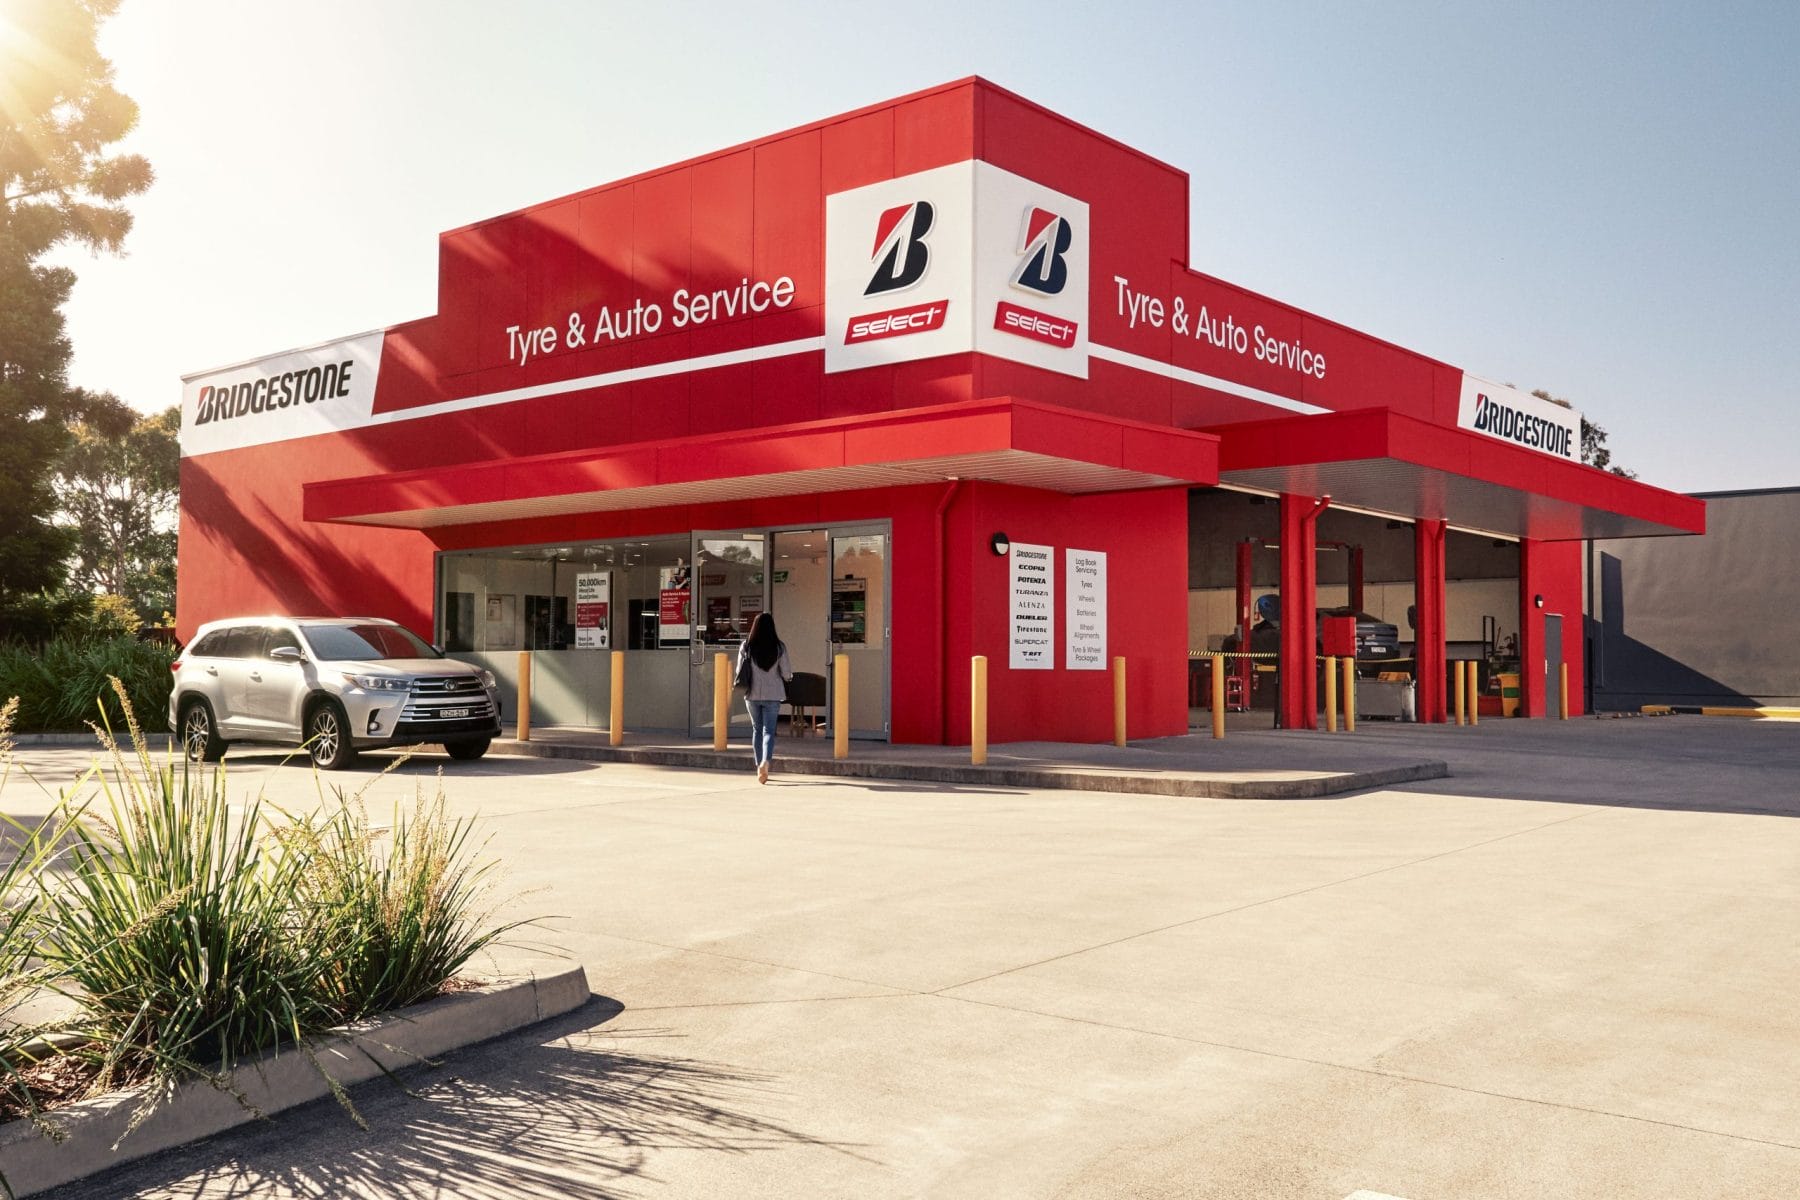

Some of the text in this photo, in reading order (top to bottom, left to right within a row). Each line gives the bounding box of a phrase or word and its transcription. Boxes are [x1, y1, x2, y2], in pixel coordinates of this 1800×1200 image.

[506, 276, 795, 366] Tyre & Auto Service
[1114, 275, 1326, 379] Tyre & Auto Service
[194, 360, 354, 426] BRIDGESTONE
[1474, 393, 1573, 458] BRIDGESTONE
[1075, 558, 1085, 567] Log
[1075, 566, 1098, 576] Servicing
[1017, 576, 1047, 584] POTENZA
[1080, 580, 1093, 589] Tyres
[1018, 601, 1046, 609] ALENZA
